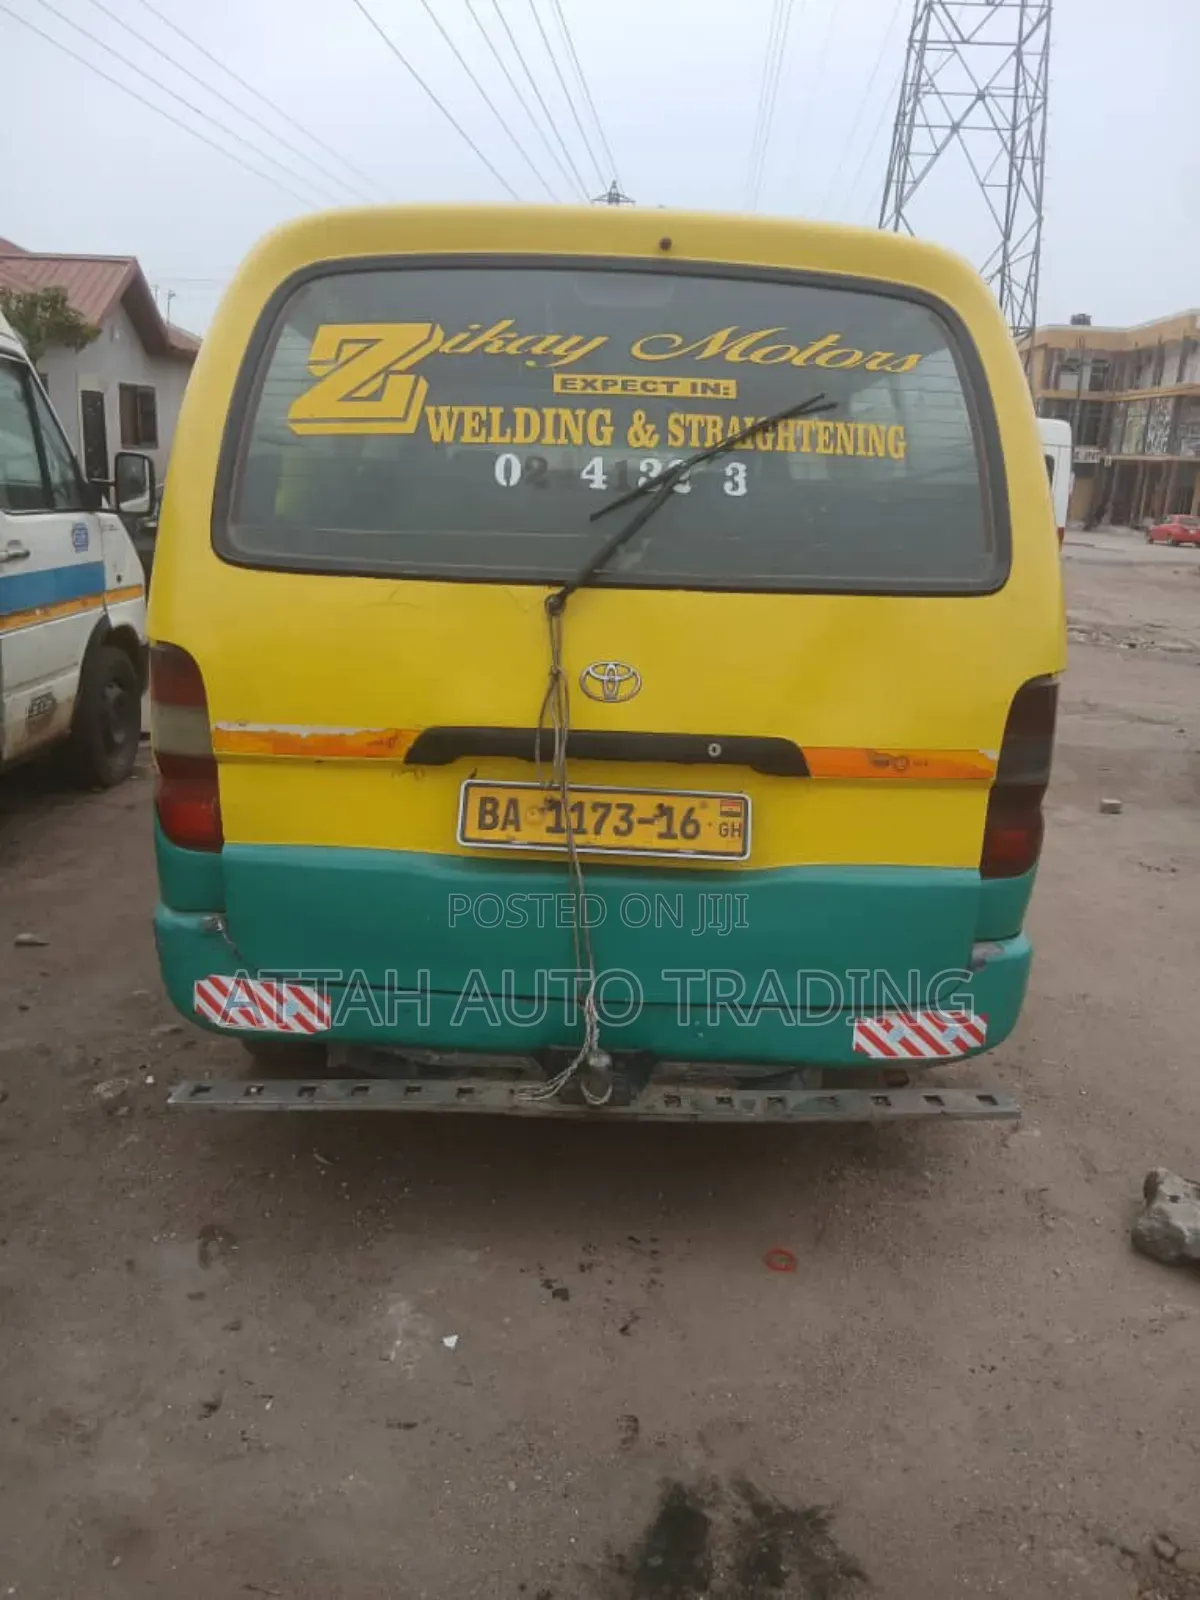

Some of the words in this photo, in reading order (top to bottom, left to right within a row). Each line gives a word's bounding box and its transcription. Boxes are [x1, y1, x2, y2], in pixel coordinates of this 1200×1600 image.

[288, 319, 610, 436] Zikay
[631, 326, 923, 374] Motors
[560, 377, 680, 393] EXPECT
[690, 382, 731, 396] IN:
[425, 406, 614, 446] WELDING
[627, 409, 660, 448] &
[667, 411, 907, 460] STRAIGHTENING
[477, 796, 521, 833] BA
[545, 797, 701, 840] 1173-16
[718, 821, 742, 838] GH
